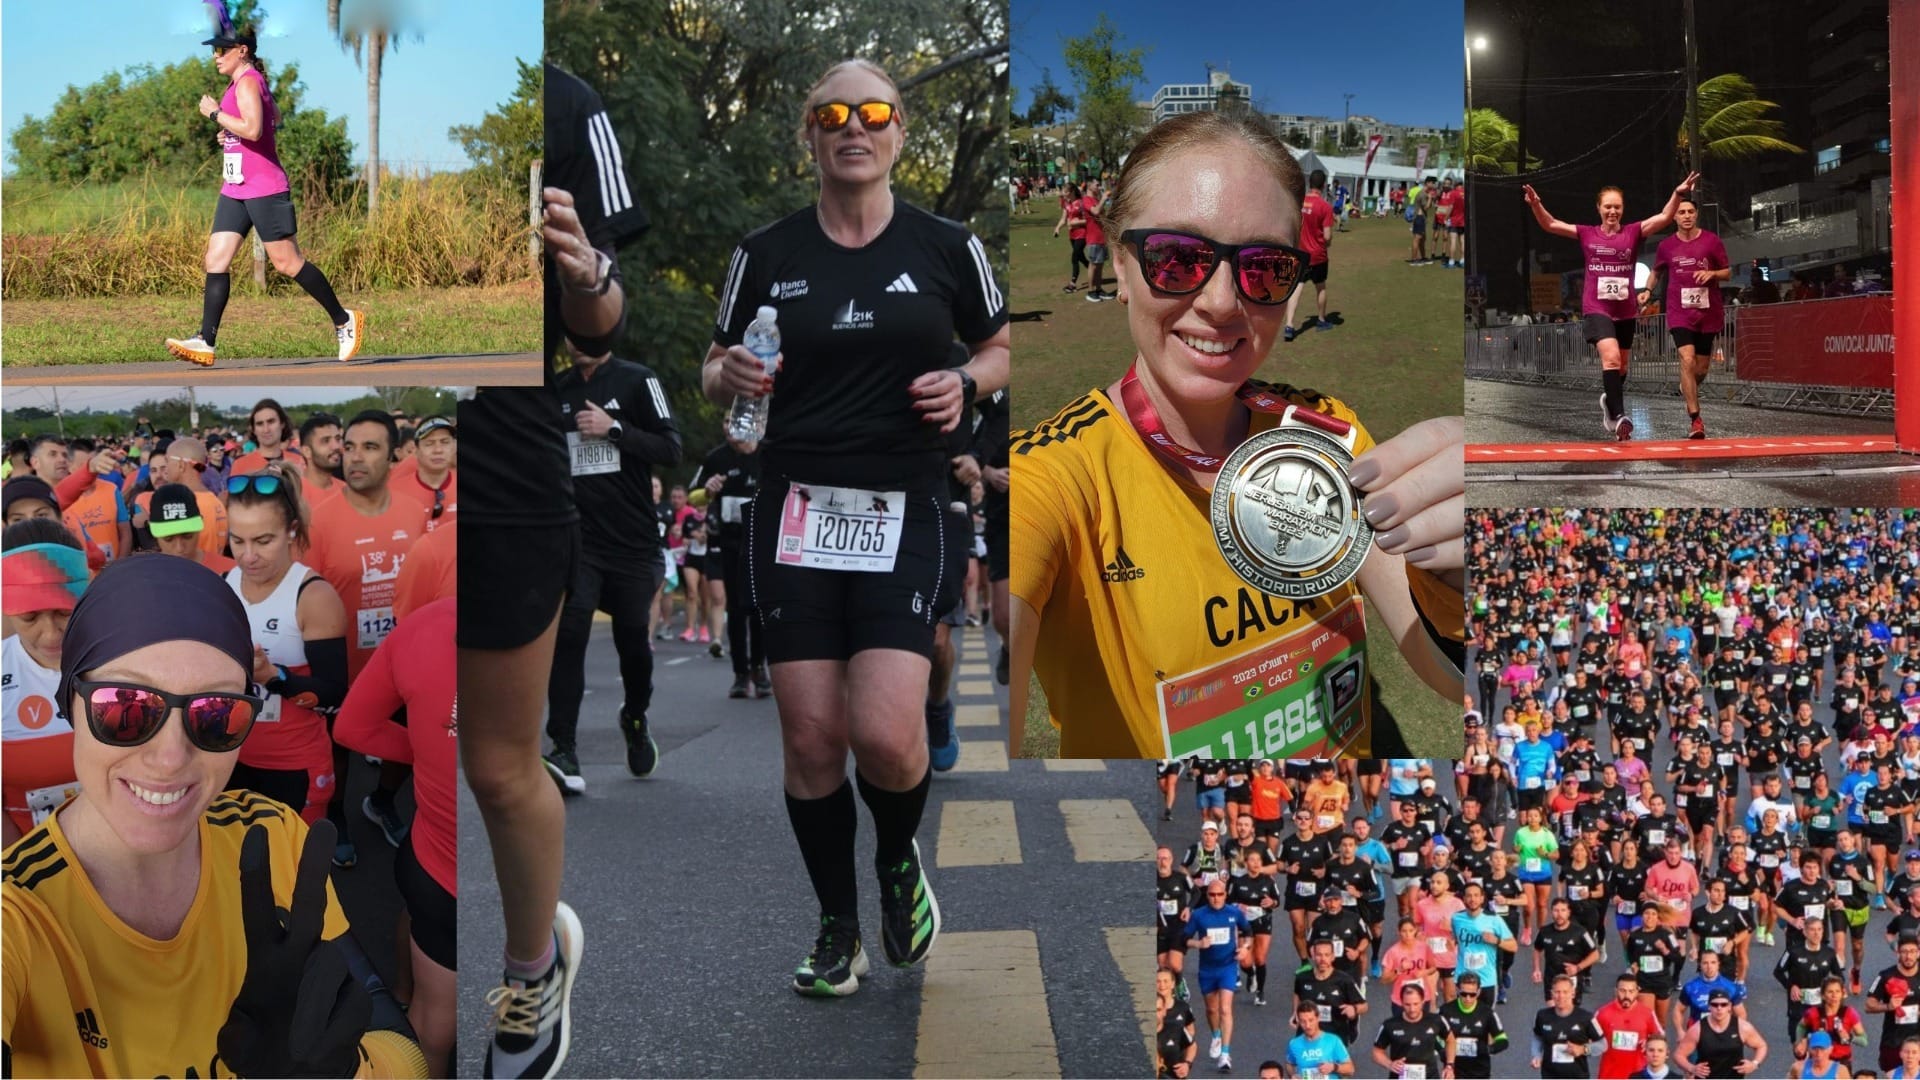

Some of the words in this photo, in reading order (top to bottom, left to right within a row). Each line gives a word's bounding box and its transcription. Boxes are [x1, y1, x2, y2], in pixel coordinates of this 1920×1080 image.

[781, 280, 807, 291] Banco
[781, 286, 809, 300] Ciudad
[1606, 285, 1619, 294] 23
[1690, 295, 1701, 304] 22
[853, 311, 875, 322] 21K
[1824, 335, 1865, 353] CONVOCA!
[577, 444, 613, 465] H19876
[163, 508, 187, 520] LIFE
[1244, 489, 1317, 521] JERUSALEM
[1264, 506, 1331, 539] MARATHON
[1269, 518, 1306, 540] 2023
[815, 514, 887, 553] i20755
[1217, 526, 1235, 551] MY
[1230, 551, 1301, 595] HISTORIC
[1305, 573, 1339, 594] RUN
[1232, 667, 1257, 685] 2023
[1268, 669, 1293, 687] CAC?
[78, 1027, 108, 1049] das
